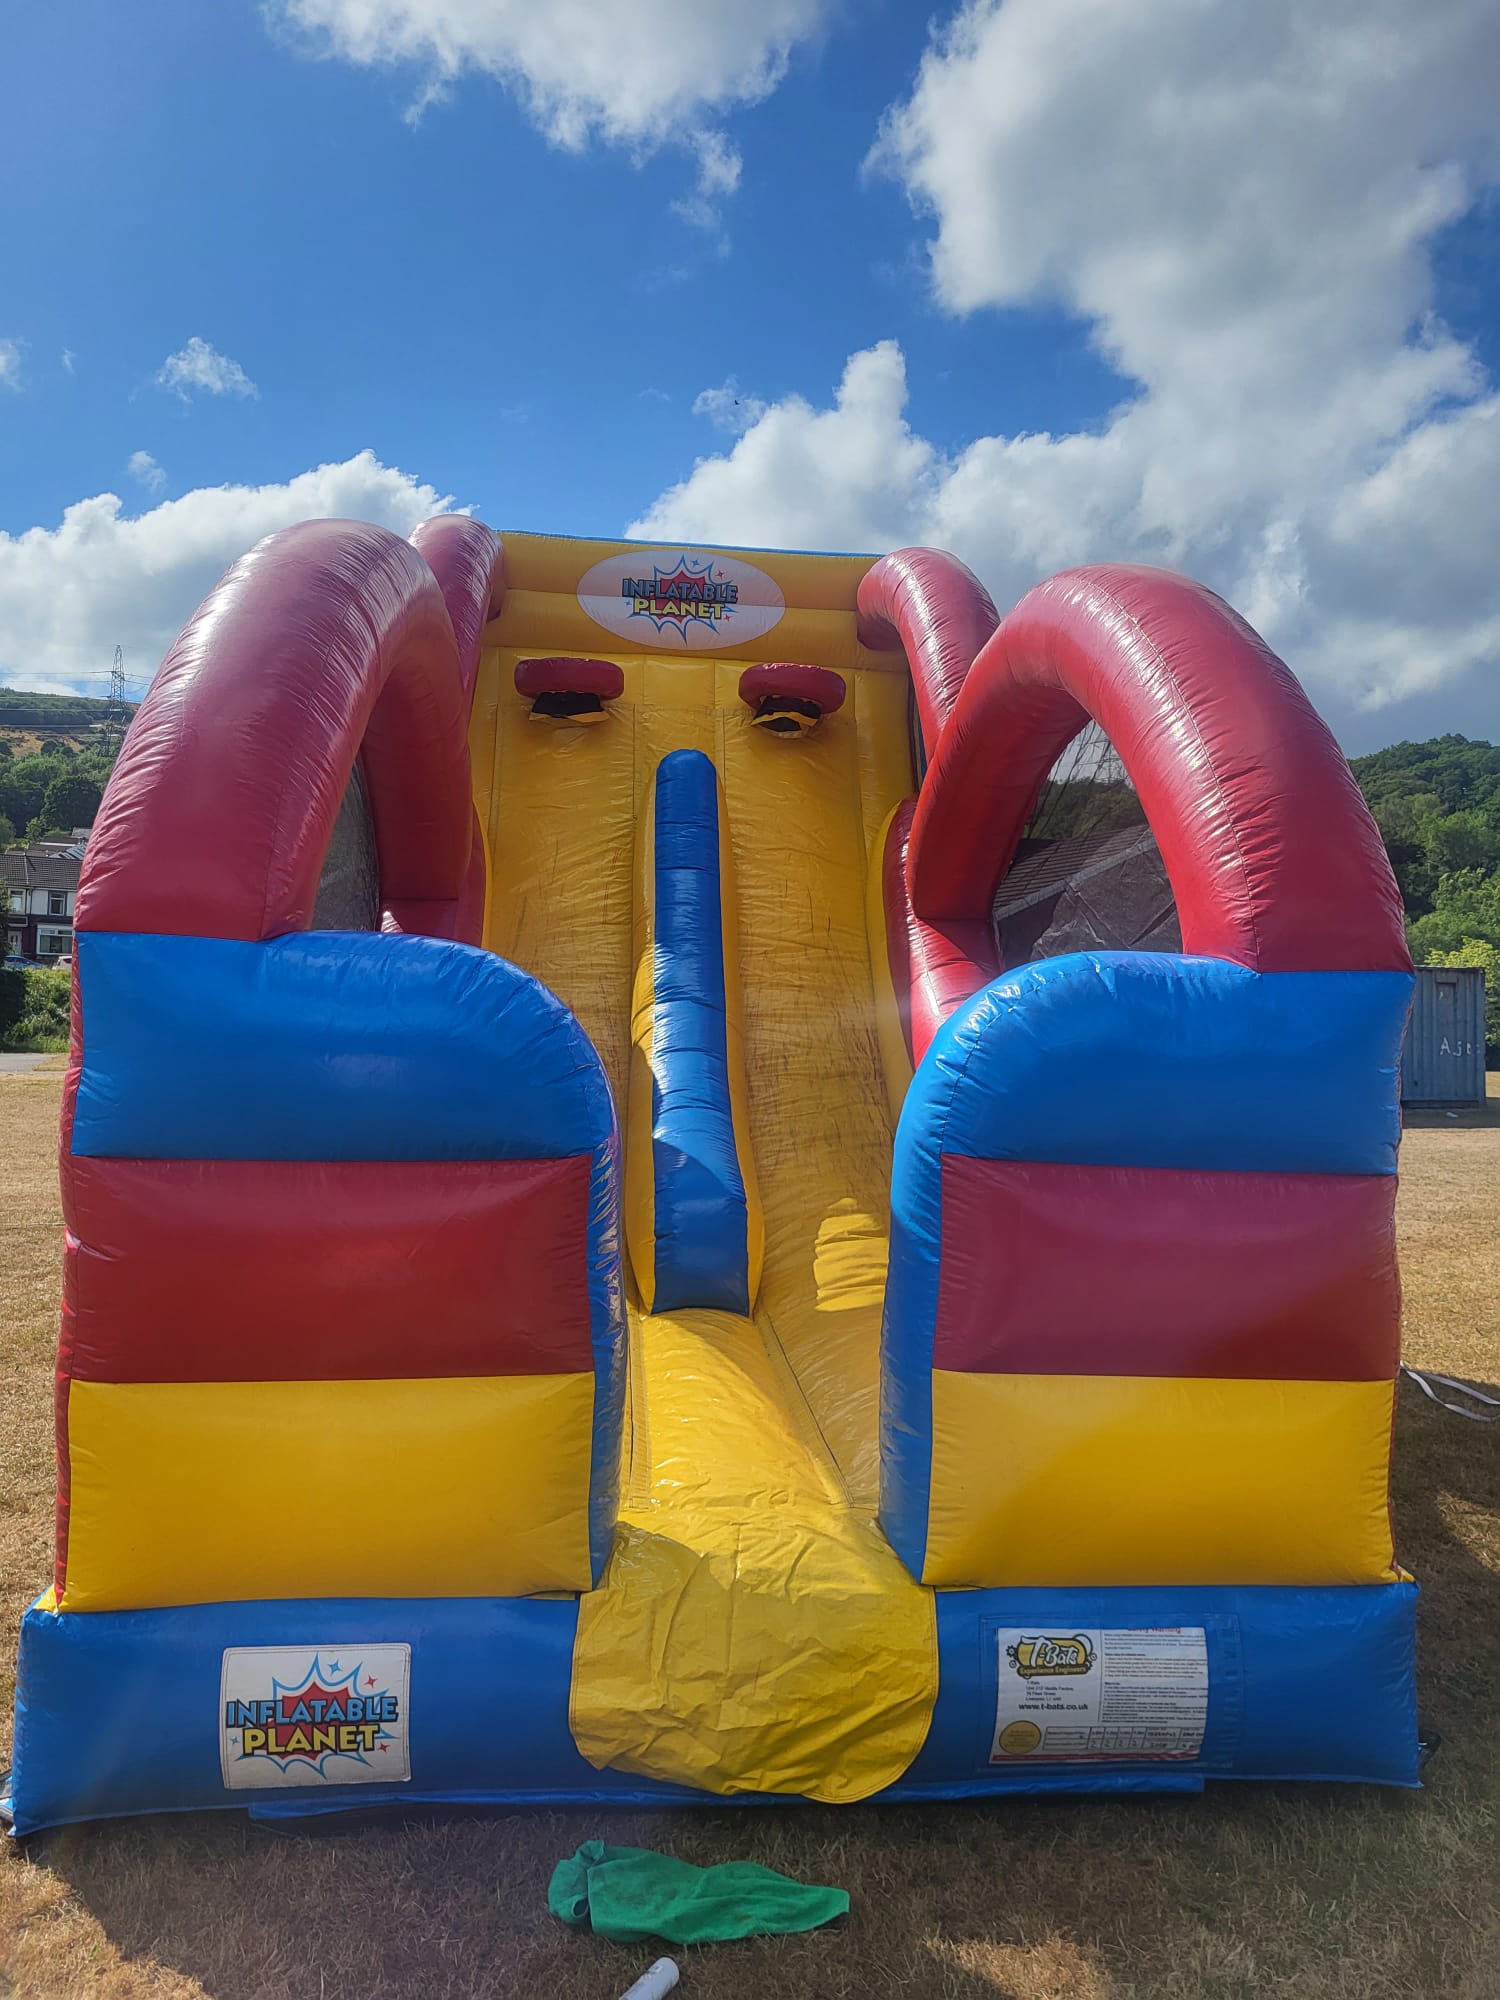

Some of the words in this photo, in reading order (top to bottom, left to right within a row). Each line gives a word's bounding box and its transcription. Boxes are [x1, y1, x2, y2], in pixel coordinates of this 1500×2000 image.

[622, 578, 738, 604] INFLATABLE
[633, 596, 726, 620] PLANET
[226, 1696, 398, 1728] INFLATABLE
[243, 1724, 380, 1756] PLANET
